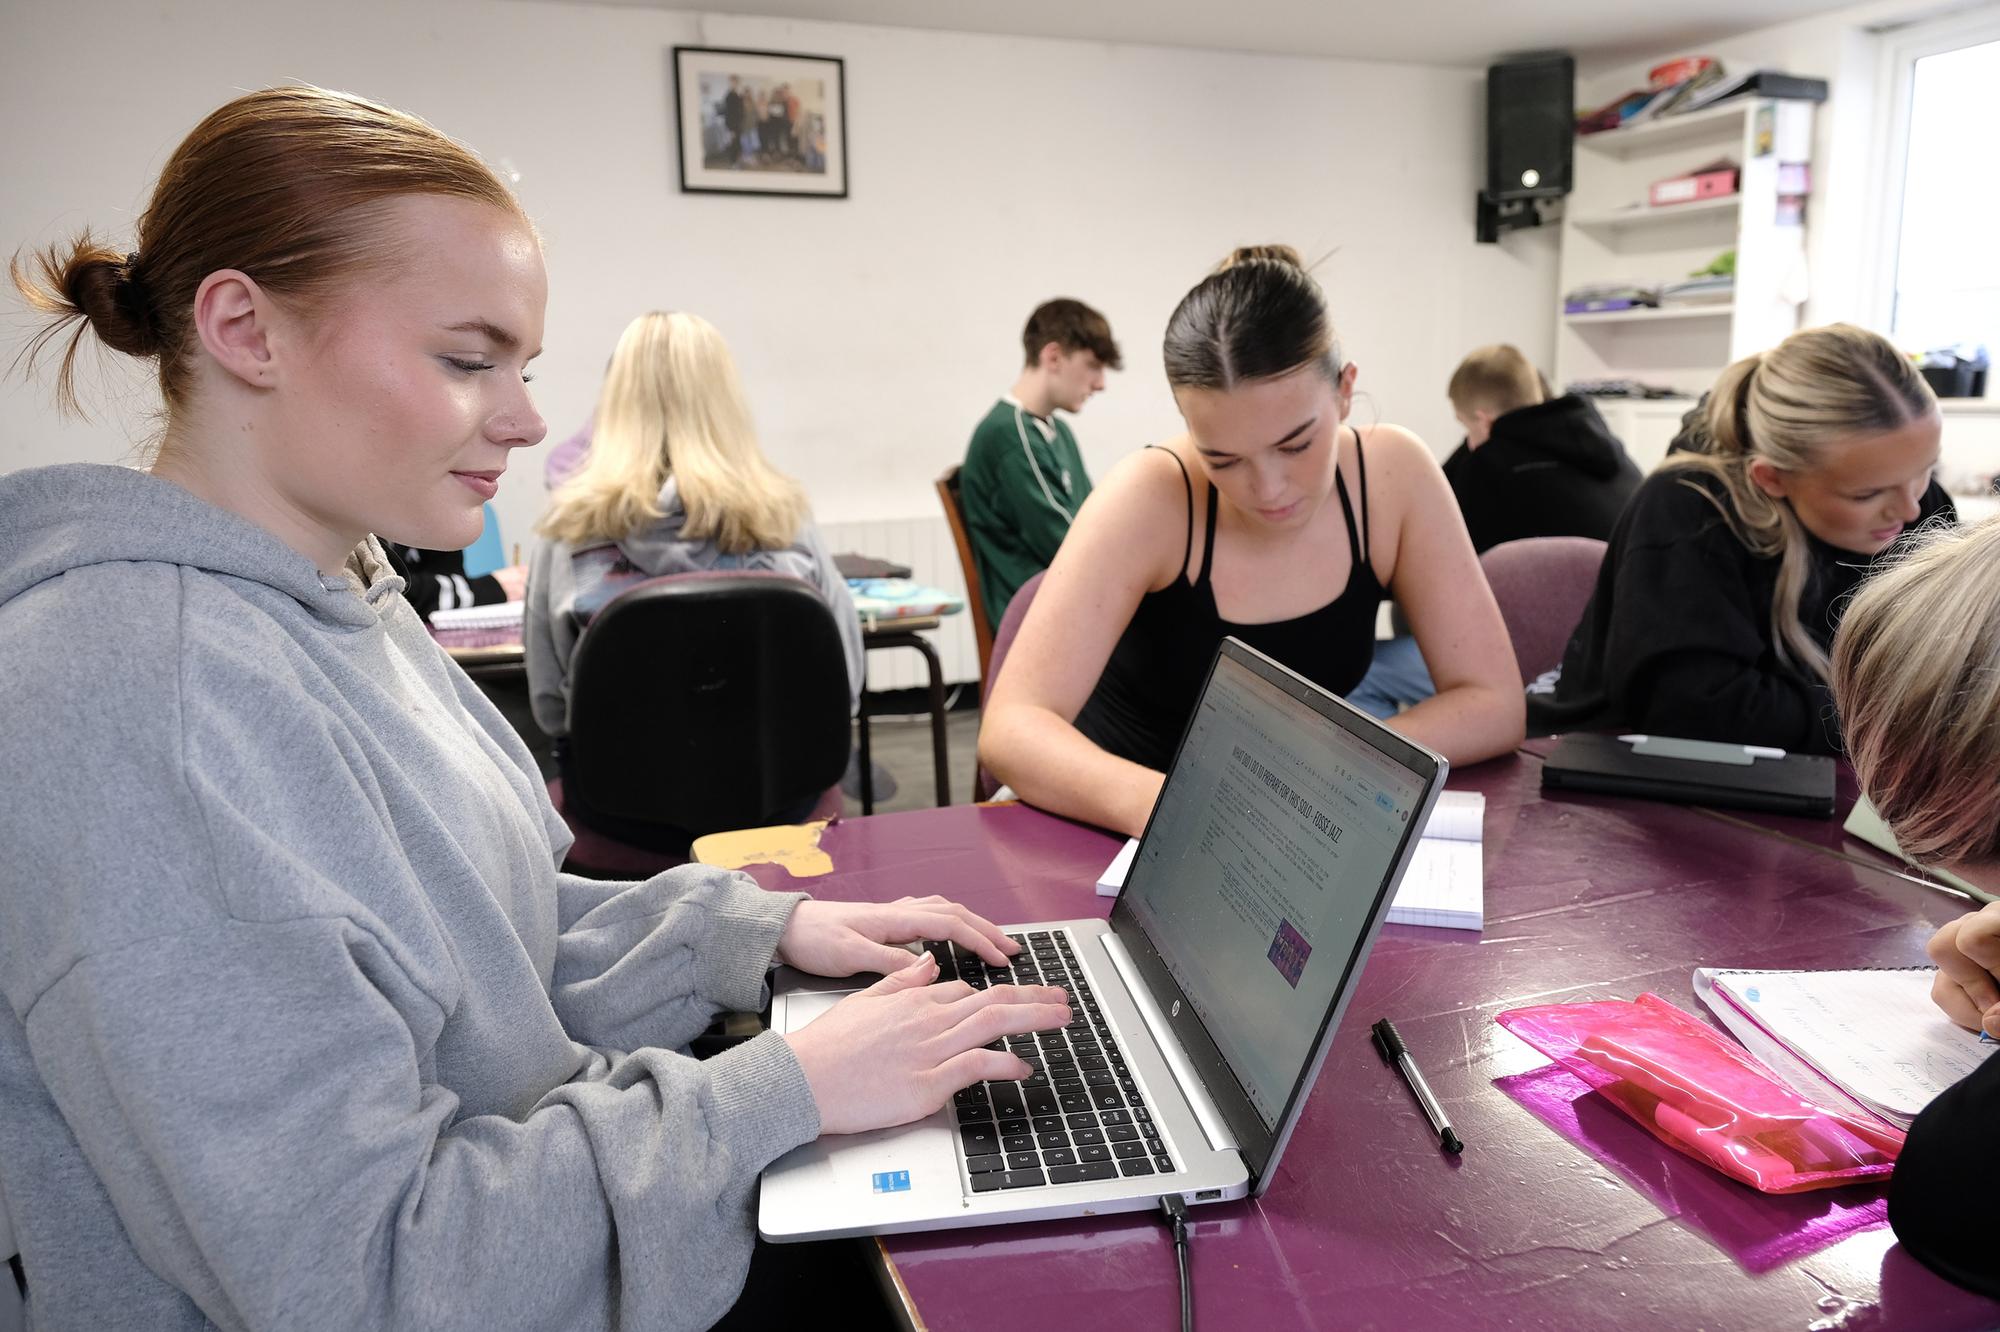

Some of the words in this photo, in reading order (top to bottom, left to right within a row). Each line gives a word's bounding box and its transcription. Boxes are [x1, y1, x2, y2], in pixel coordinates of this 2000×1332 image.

[1256, 764, 1265, 780] TO
[1261, 769, 1282, 794] PREPARE
[1279, 783, 1290, 800] FOR
[1287, 790, 1301, 809] THIS
[1298, 798, 1313, 819] SOLO
[1312, 810, 1331, 834] FOSSE
[1327, 823, 1343, 844] JAZZ
